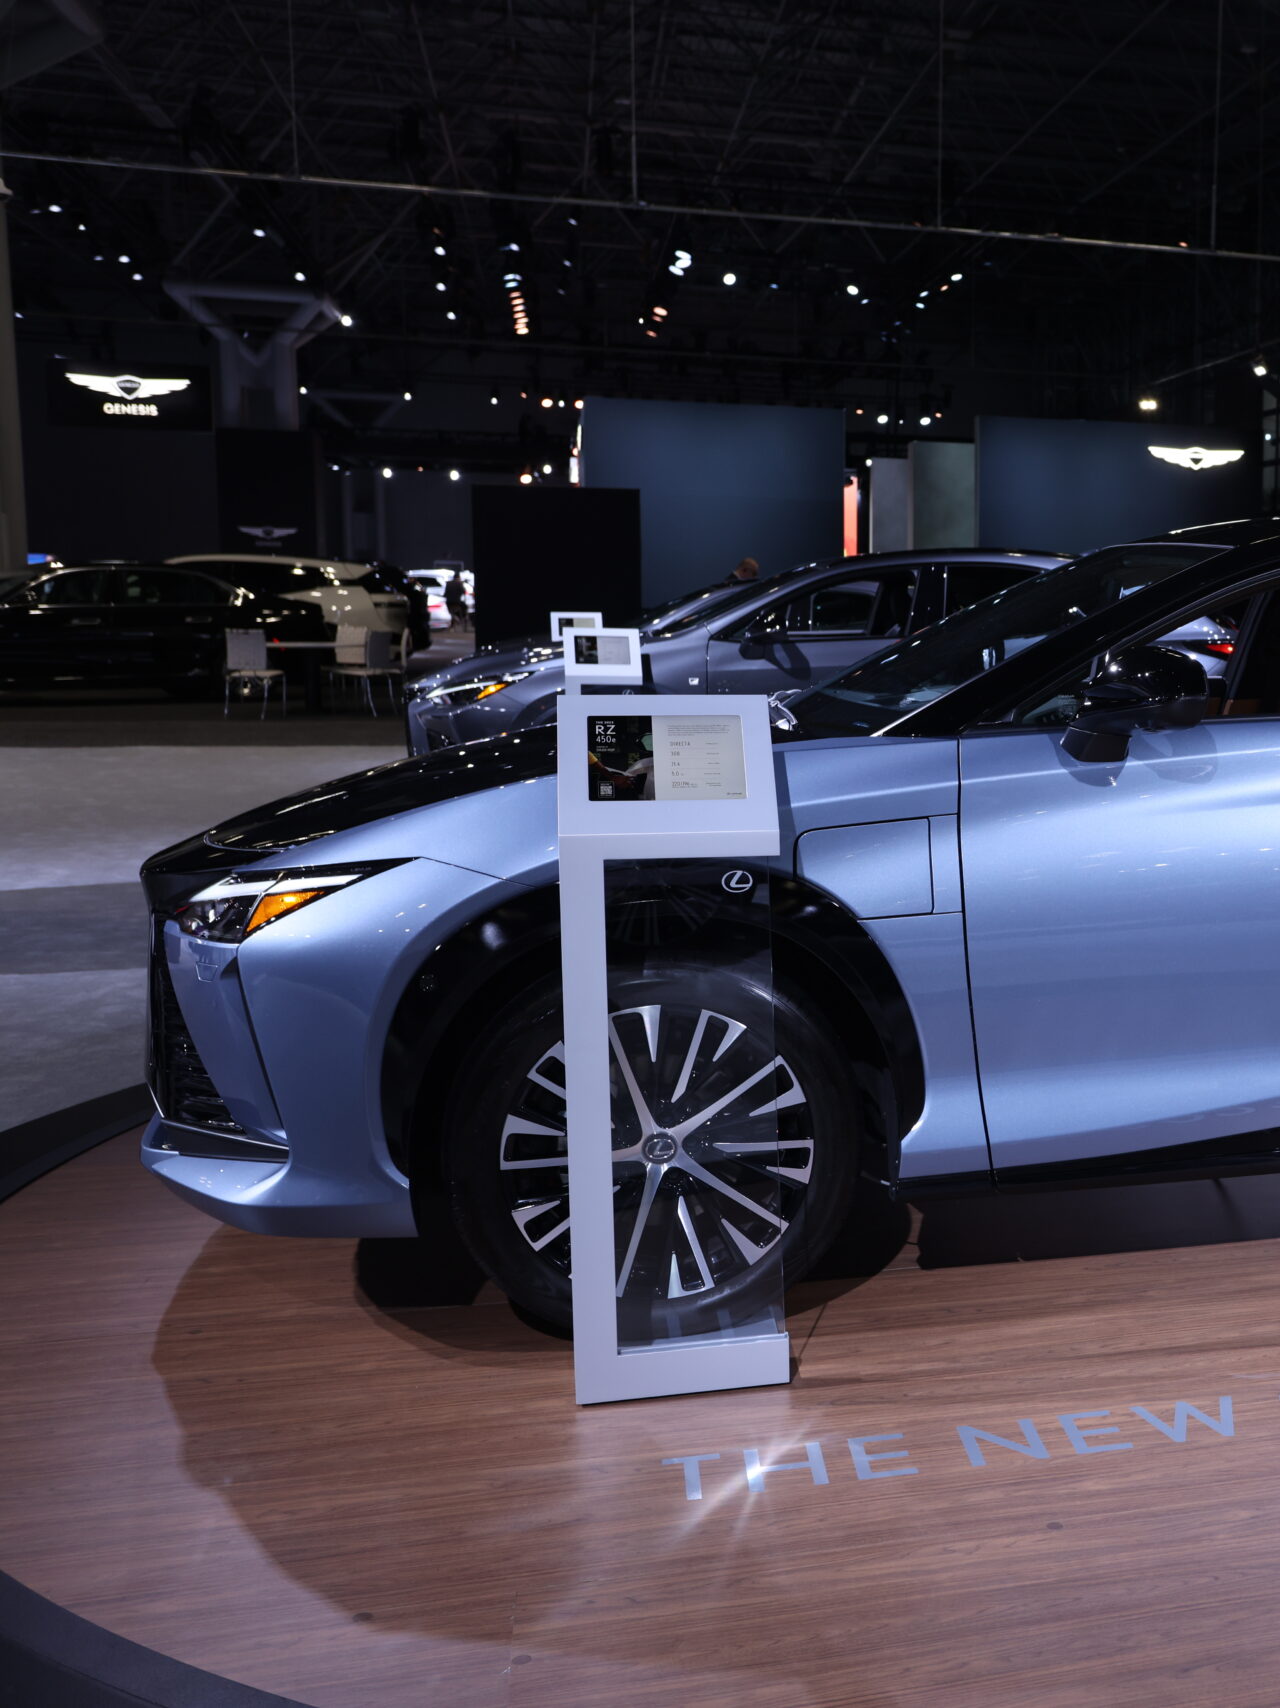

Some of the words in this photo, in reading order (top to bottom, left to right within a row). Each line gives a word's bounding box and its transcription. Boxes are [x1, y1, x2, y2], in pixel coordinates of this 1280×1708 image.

[103, 402, 158, 416] GENESIS
[595, 725, 616, 734] RZ
[596, 735, 616, 743] 450e
[661, 1433, 919, 1500] THE
[956, 1396, 1235, 1467] NEW
